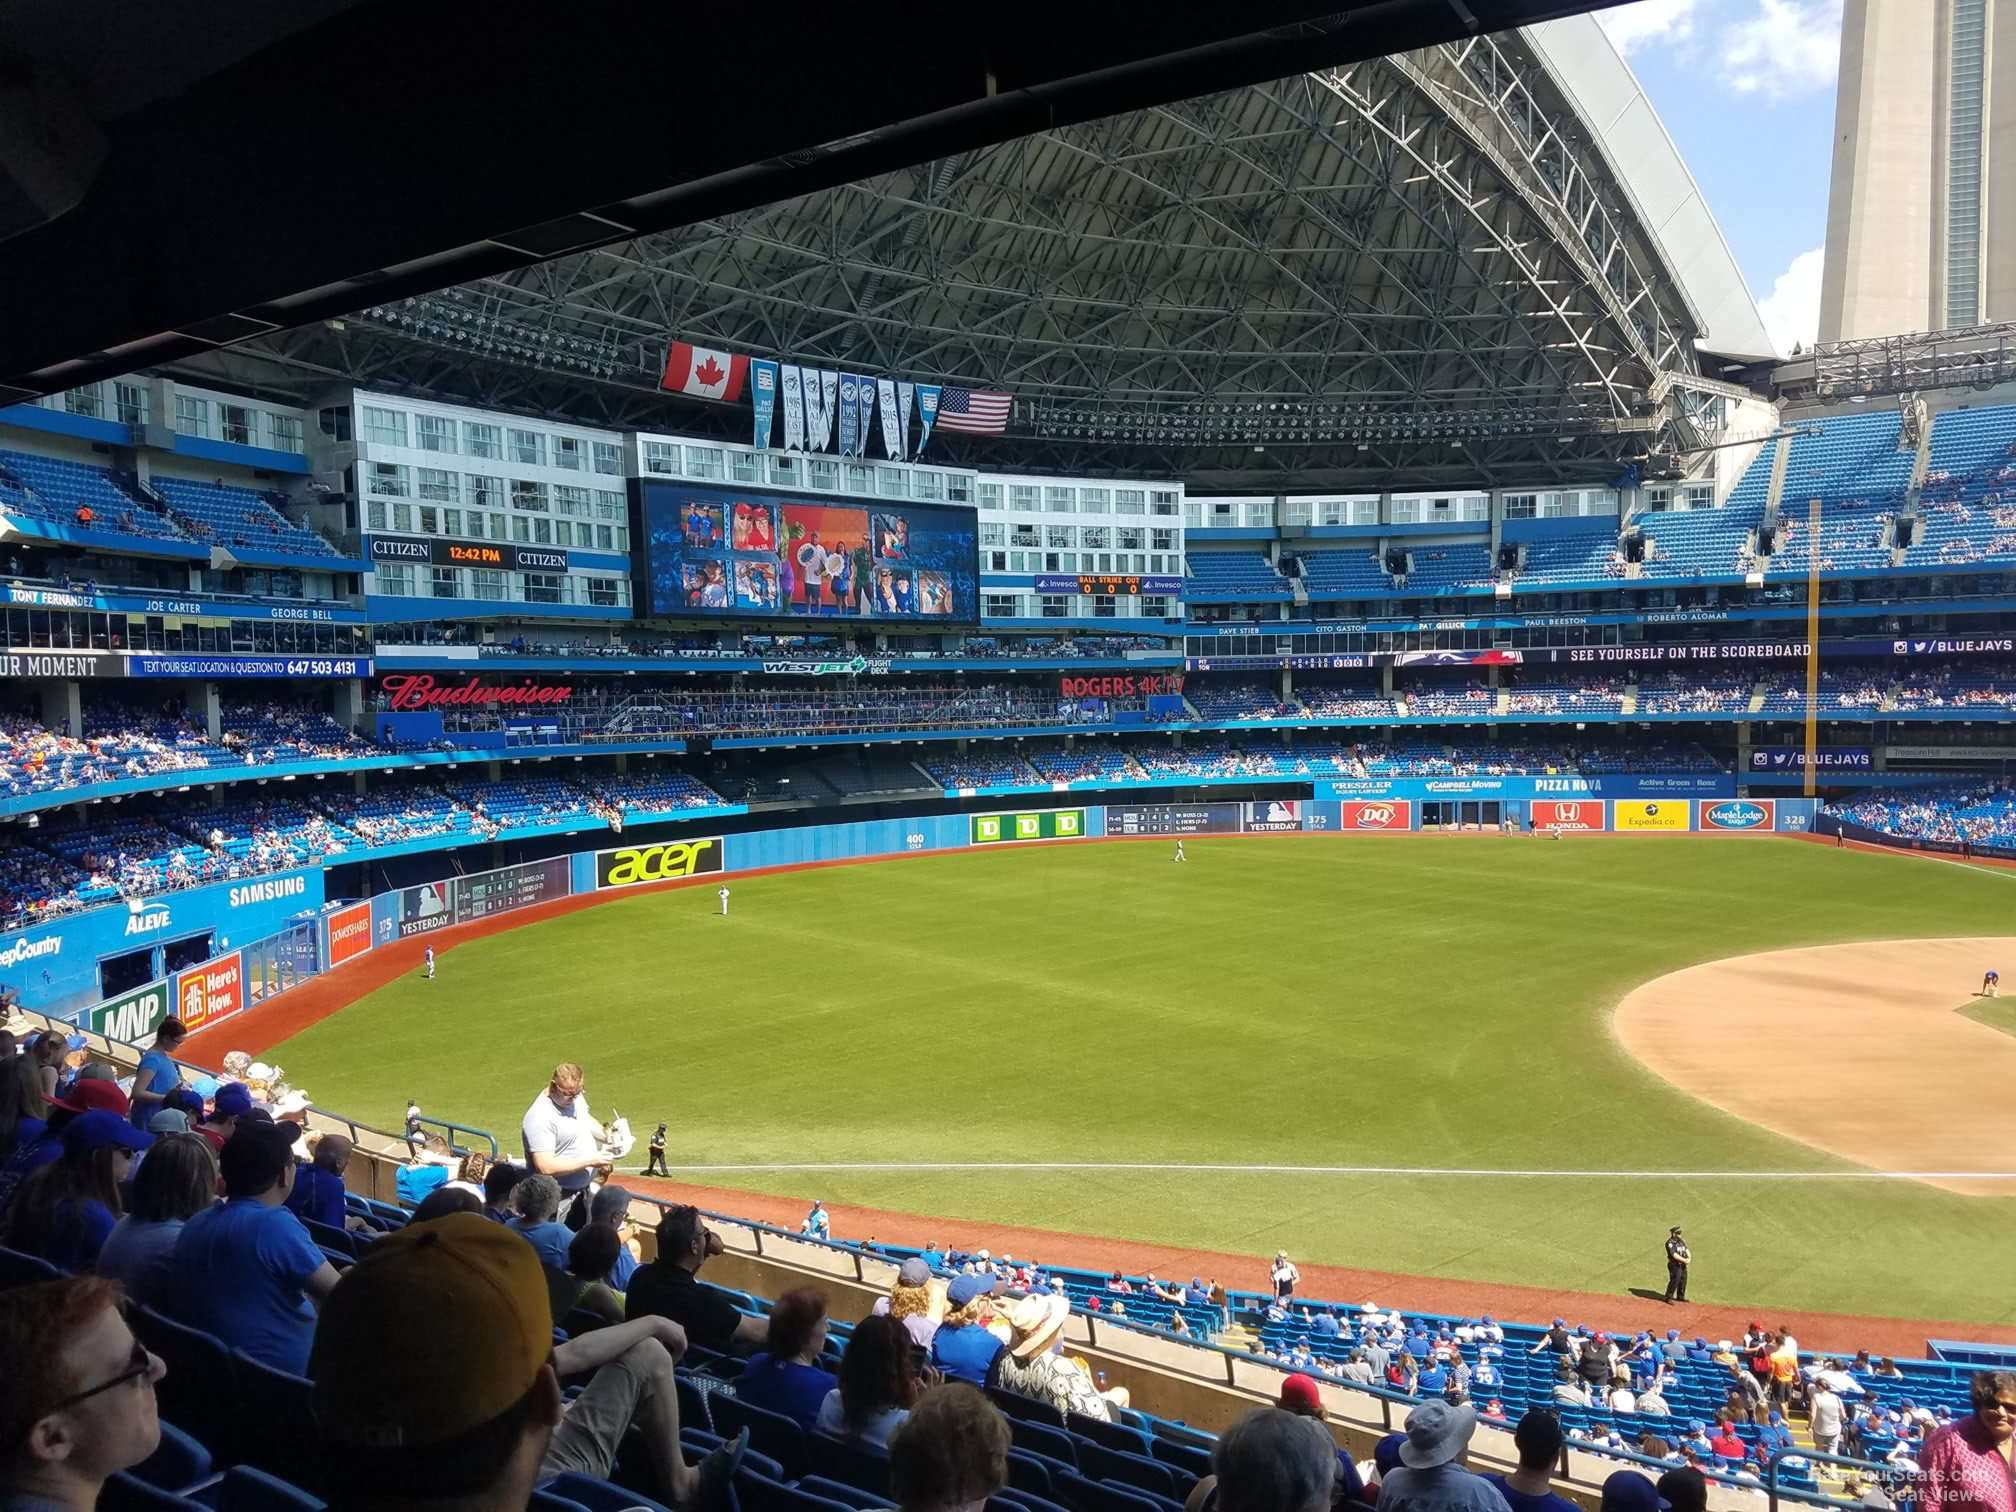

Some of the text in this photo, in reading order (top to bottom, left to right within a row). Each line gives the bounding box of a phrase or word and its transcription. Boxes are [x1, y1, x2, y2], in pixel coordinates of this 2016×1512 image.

[842, 405, 856, 417] 1992
[882, 409, 897, 421] 2015
[373, 540, 566, 567] CITIZEN 12:42 PM CITIZEN
[1049, 580, 1078, 589] Invesco
[1079, 576, 1140, 584] BALL STRIKE OUT
[1154, 580, 1182, 590] Invesco
[1084, 584, 1137, 594] 0 0 0
[11, 589, 94, 608] TONY FERNANDEZ
[146, 600, 201, 613] JOE CARTER
[271, 608, 332, 620] GEORGE BELL
[1647, 612, 1728, 622] ROBERTO ALOMAR
[1549, 617, 1586, 625] BEESTON
[1240, 627, 1259, 635] STIEB
[1336, 624, 1367, 632] GASTON
[1570, 644, 1812, 661] SEE YOURSELF ON THE SCOREBOARD
[27, 656, 97, 676] MOMENT
[143, 660, 356, 675] TEXT YOUR SEAT LOCATION & QUESTION TO 647 503 4131
[764, 662, 849, 675] WESTJET
[868, 659, 892, 667] FLIGHT
[871, 667, 889, 675] DECK
[382, 674, 572, 709] Budweiser
[1061, 675, 1185, 696] ROGERS 4K TV
[1331, 781, 1392, 789] PRESZLER
[1535, 779, 1602, 791] PIZZA NOVA
[1308, 815, 1327, 824] 375
[1363, 808, 1388, 822] DQ
[1784, 815, 1806, 824] 328
[979, 819, 999, 836] TD
[1020, 817, 1039, 834] TD
[1057, 814, 1078, 832] TD
[1250, 823, 1297, 831] YESTERDAY
[1629, 818, 1675, 827] Expedia.ca
[907, 833, 924, 844] 400
[608, 839, 712, 885] acer
[229, 876, 305, 907] SAMSUNG
[473, 904, 484, 912] TEX
[488, 902, 492, 910] 8
[498, 899, 502, 907] 9
[508, 897, 513, 905] 2
[125, 909, 172, 936] ALEVE
[379, 918, 392, 934] 375
[401, 914, 449, 935] YESTERDAY
[0, 936, 62, 968] epCountry
[207, 966, 237, 993] Here's
[207, 993, 233, 1015] How.
[104, 993, 159, 1042] MNP
